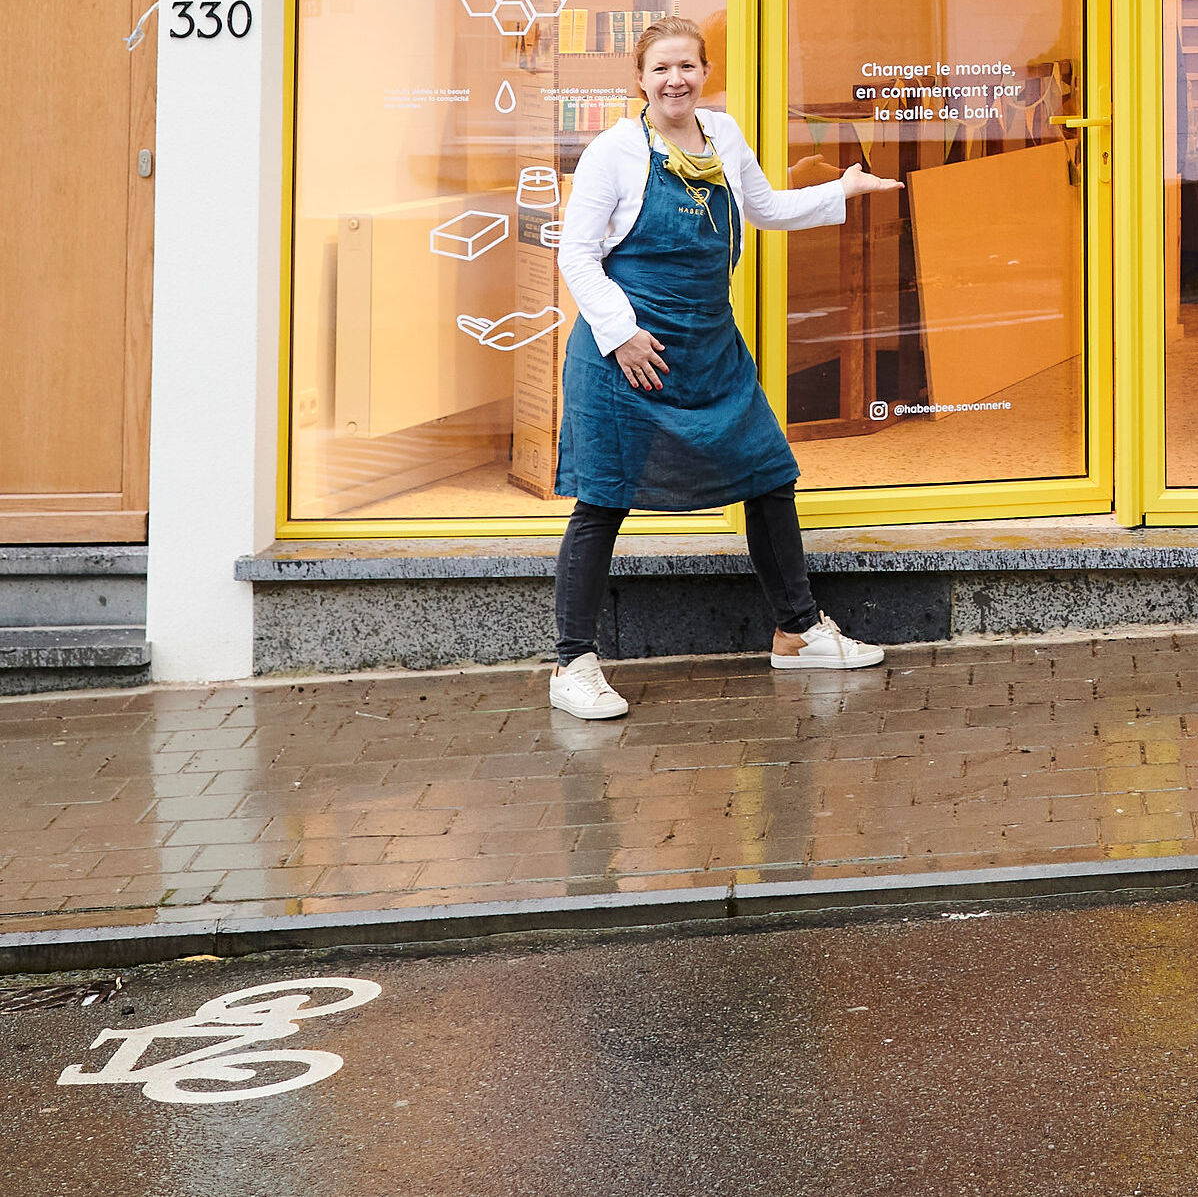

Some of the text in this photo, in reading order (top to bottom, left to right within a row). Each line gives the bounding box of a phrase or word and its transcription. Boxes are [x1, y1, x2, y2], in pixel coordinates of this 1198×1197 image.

[170, 0, 253, 39] 330
[861, 61, 1016, 79] Changer le monde,
[855, 84, 1022, 100] en commençant par
[874, 105, 1003, 121] la salle de bain.
[894, 400, 1012, 416] @habeebee.savonnerie
